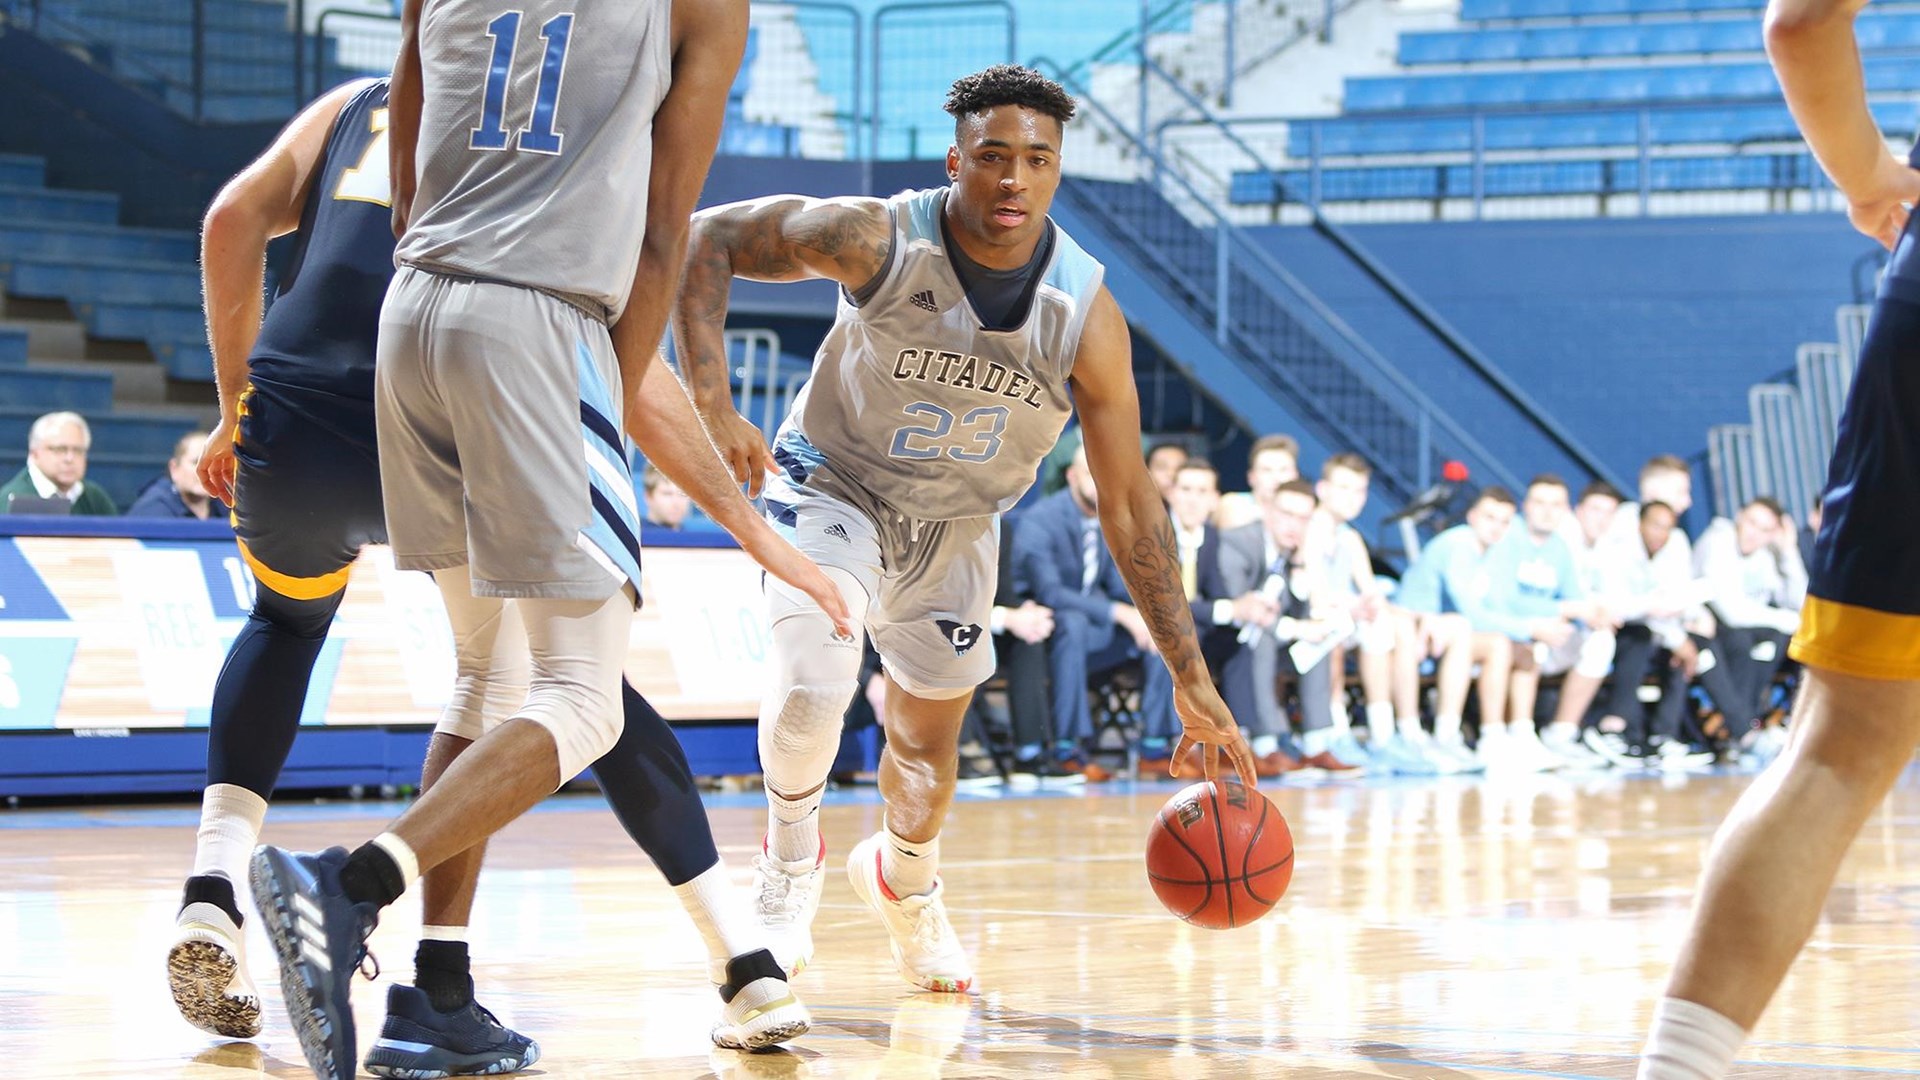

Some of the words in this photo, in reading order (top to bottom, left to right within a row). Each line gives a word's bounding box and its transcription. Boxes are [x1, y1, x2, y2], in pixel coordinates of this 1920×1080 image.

[469, 10, 575, 155] 11
[909, 295, 938, 313] adidas
[892, 347, 1043, 411] CITADEL
[888, 401, 1012, 464] 23
[700, 606, 775, 663] 1:0
[951, 625, 971, 647] C
